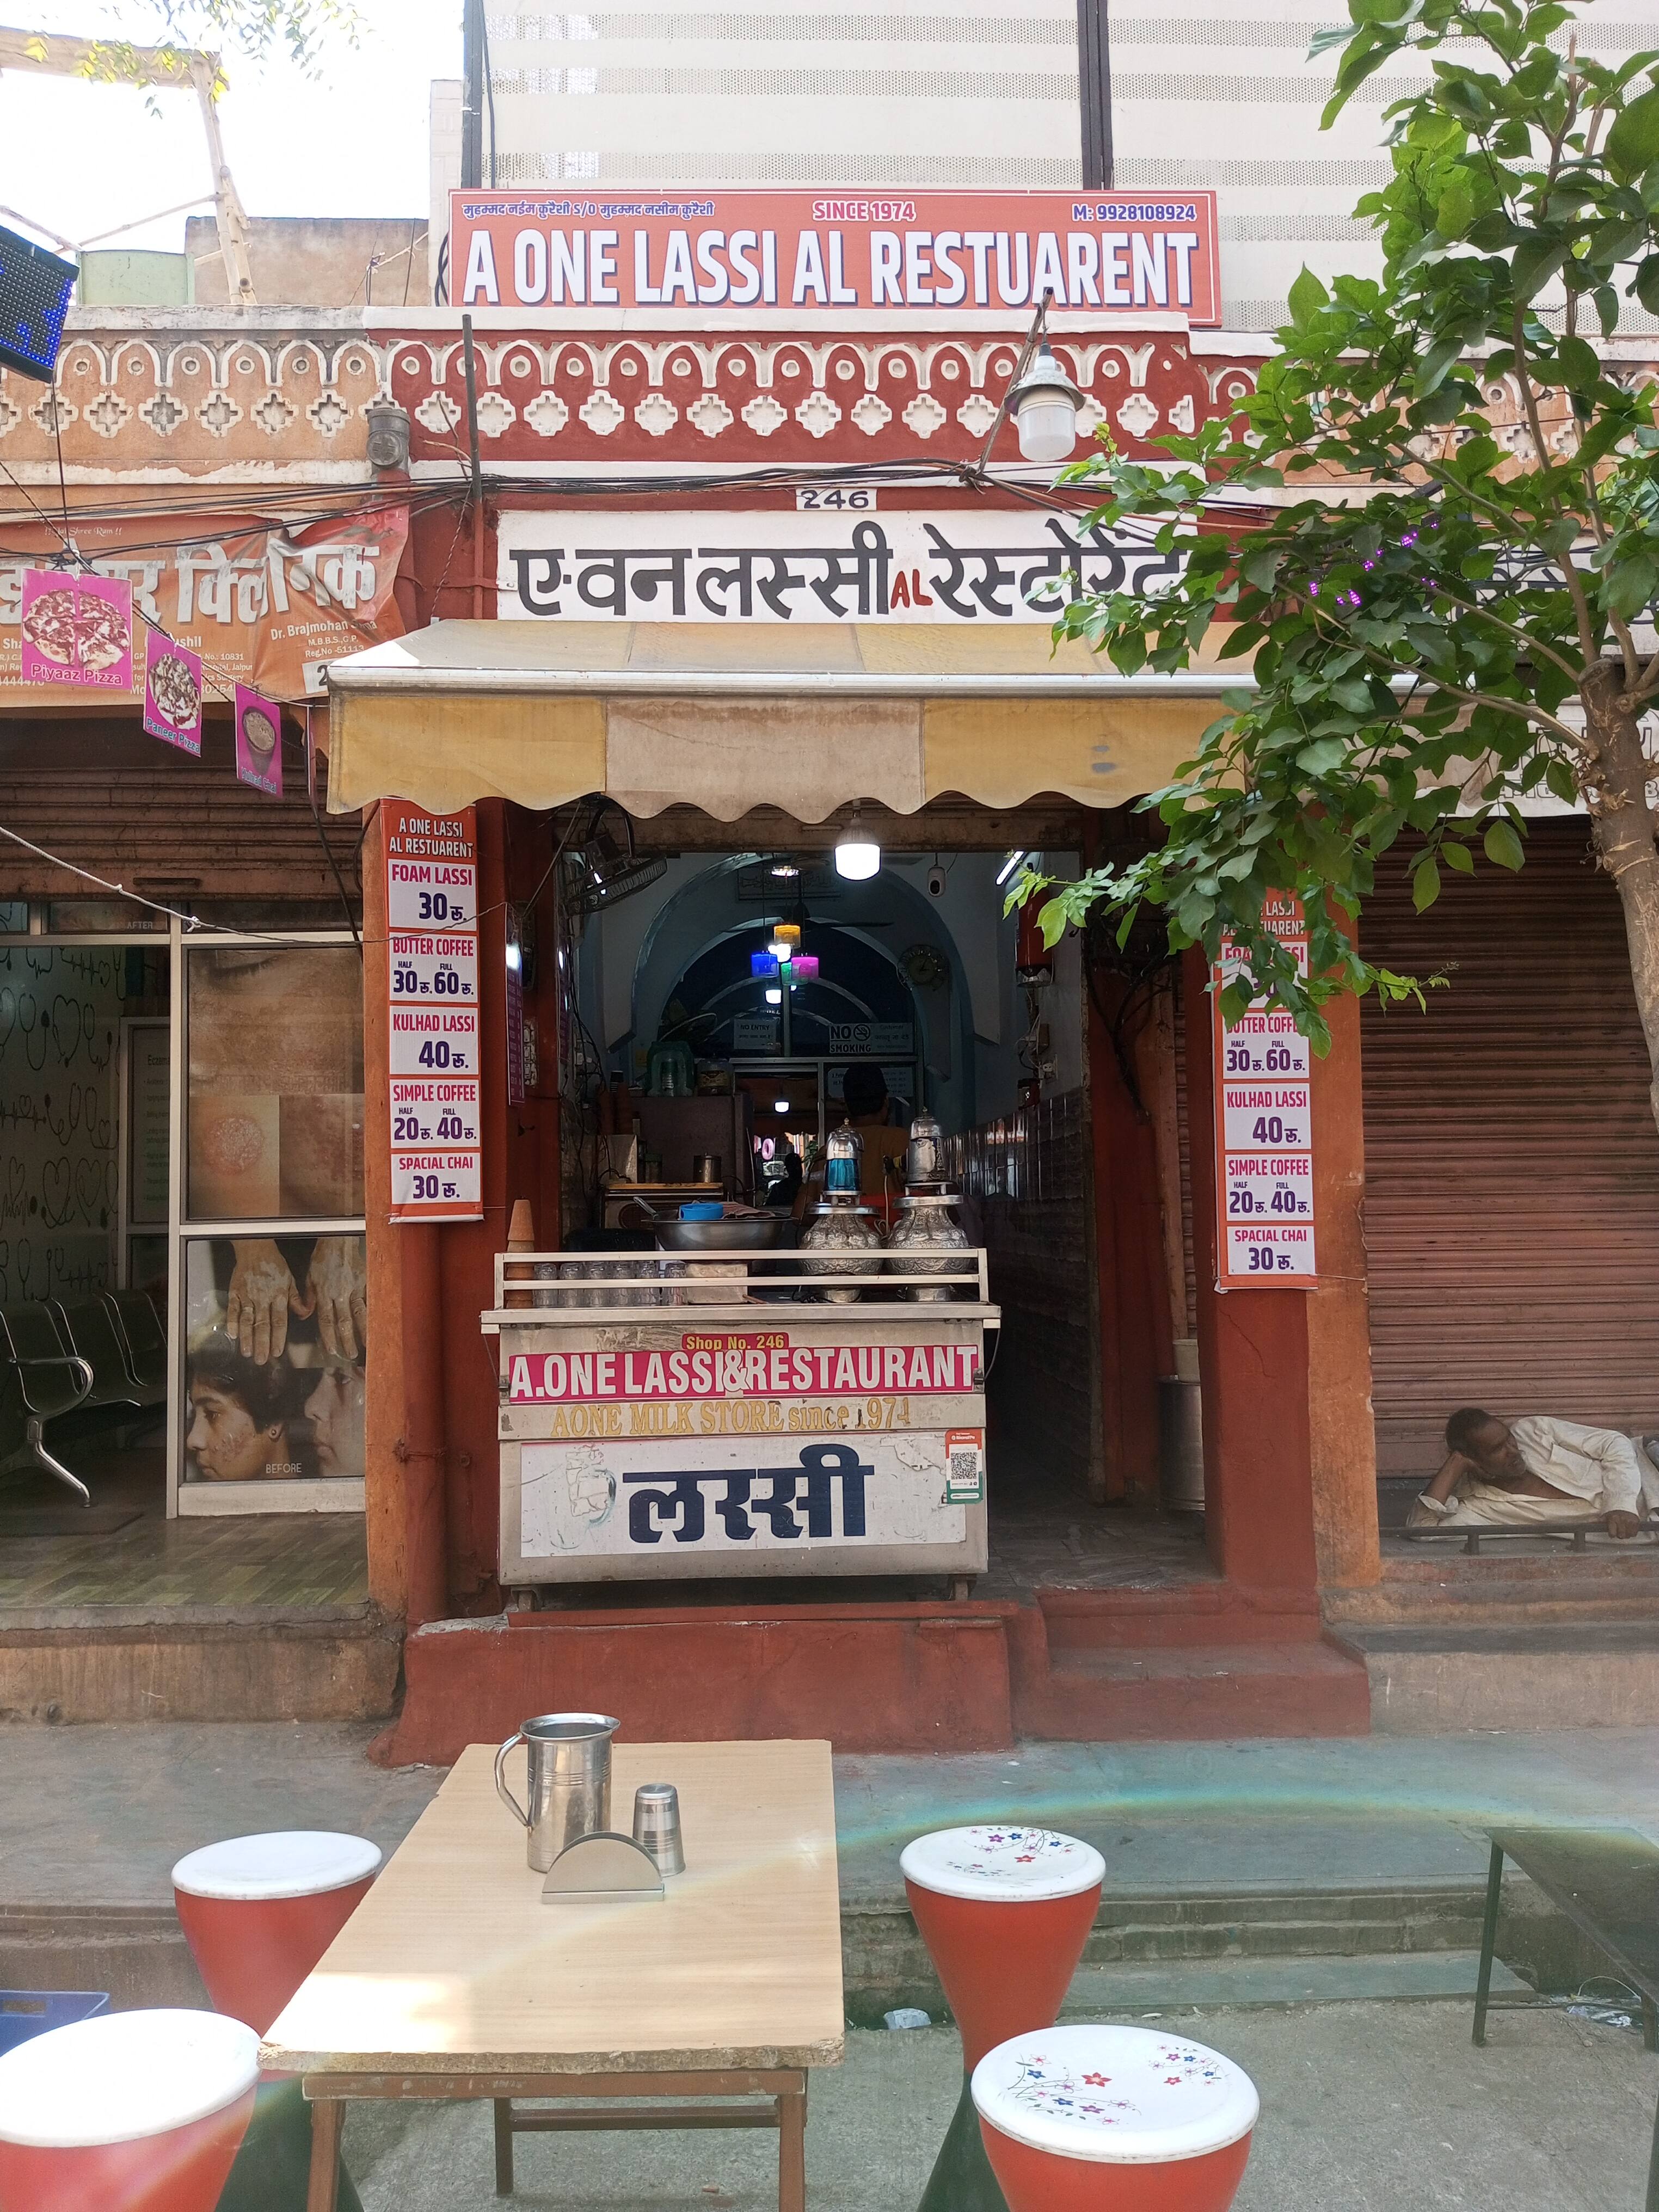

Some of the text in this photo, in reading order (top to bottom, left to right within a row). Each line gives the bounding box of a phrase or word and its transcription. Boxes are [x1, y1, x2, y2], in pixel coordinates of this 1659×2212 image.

[508, 200, 536, 216] नईम
[644, 201, 679, 216] नसीम
[814, 201, 915, 220] SINCE 1974
[1073, 205, 1196, 221] M: 9928108924
[463, 230, 1198, 306] A ONE LASSI AL RESTUARENT
[800, 489, 869, 509] 246
[696, 520, 894, 620] लस्सी
[890, 568, 933, 610] AL
[270, 628, 286, 641] Dr.
[286, 619, 349, 637] Brajmohan
[220, 653, 244, 661] 10831
[31, 663, 80, 681] Piyaaz
[84, 669, 123, 685] Pizza
[146, 717, 201, 754] Paneer Pizza
[398, 817, 463, 838] A ONE LASSI
[389, 837, 474, 858] AL RESTUARENT
[391, 864, 472, 886] FOAM LASSI
[419, 892, 447, 920] 30
[127, 921, 153, 930] AFTER
[392, 937, 474, 957] BUTTER COFFEE
[398, 961, 453, 971] HALF FULL
[393, 970, 417, 994] 30
[434, 972, 459, 995] 60
[393, 1013, 475, 1033] KULHAD LASSI
[830, 1025, 851, 1040] NO
[1228, 1016, 1265, 1034] UTTER
[418, 1041, 450, 1068] 40
[830, 1043, 871, 1053] SMOKING
[1226, 1049, 1250, 1072] 30
[1266, 1048, 1291, 1071] 60
[393, 1084, 476, 1102] SIMPLE COFFEE
[1226, 1091, 1307, 1108] KULHAD LASSI
[394, 1117, 419, 1140] 20
[437, 1117, 463, 1140] 40
[1252, 1116, 1282, 1144] 40
[399, 1156, 474, 1170] SPACIAL CHAI
[1228, 1159, 1309, 1176] SIMPLE COFFEE
[413, 1175, 439, 1199] 30
[1229, 1191, 1253, 1213] 20
[1270, 1190, 1296, 1213] 40
[1234, 1229, 1307, 1242] SPACIAL CHAI
[1248, 1247, 1274, 1270] 30
[686, 1335, 784, 1351] Shop No. 246
[510, 1353, 616, 1398] A.ONE
[629, 1403, 695, 1435] MILK
[699, 1399, 784, 1434] STORE
[788, 1406, 850, 1430] since
[854, 1397, 911, 1429] 1974
[265, 1463, 303, 1474] BEFORE
[623, 1443, 875, 1544] लस्सी
